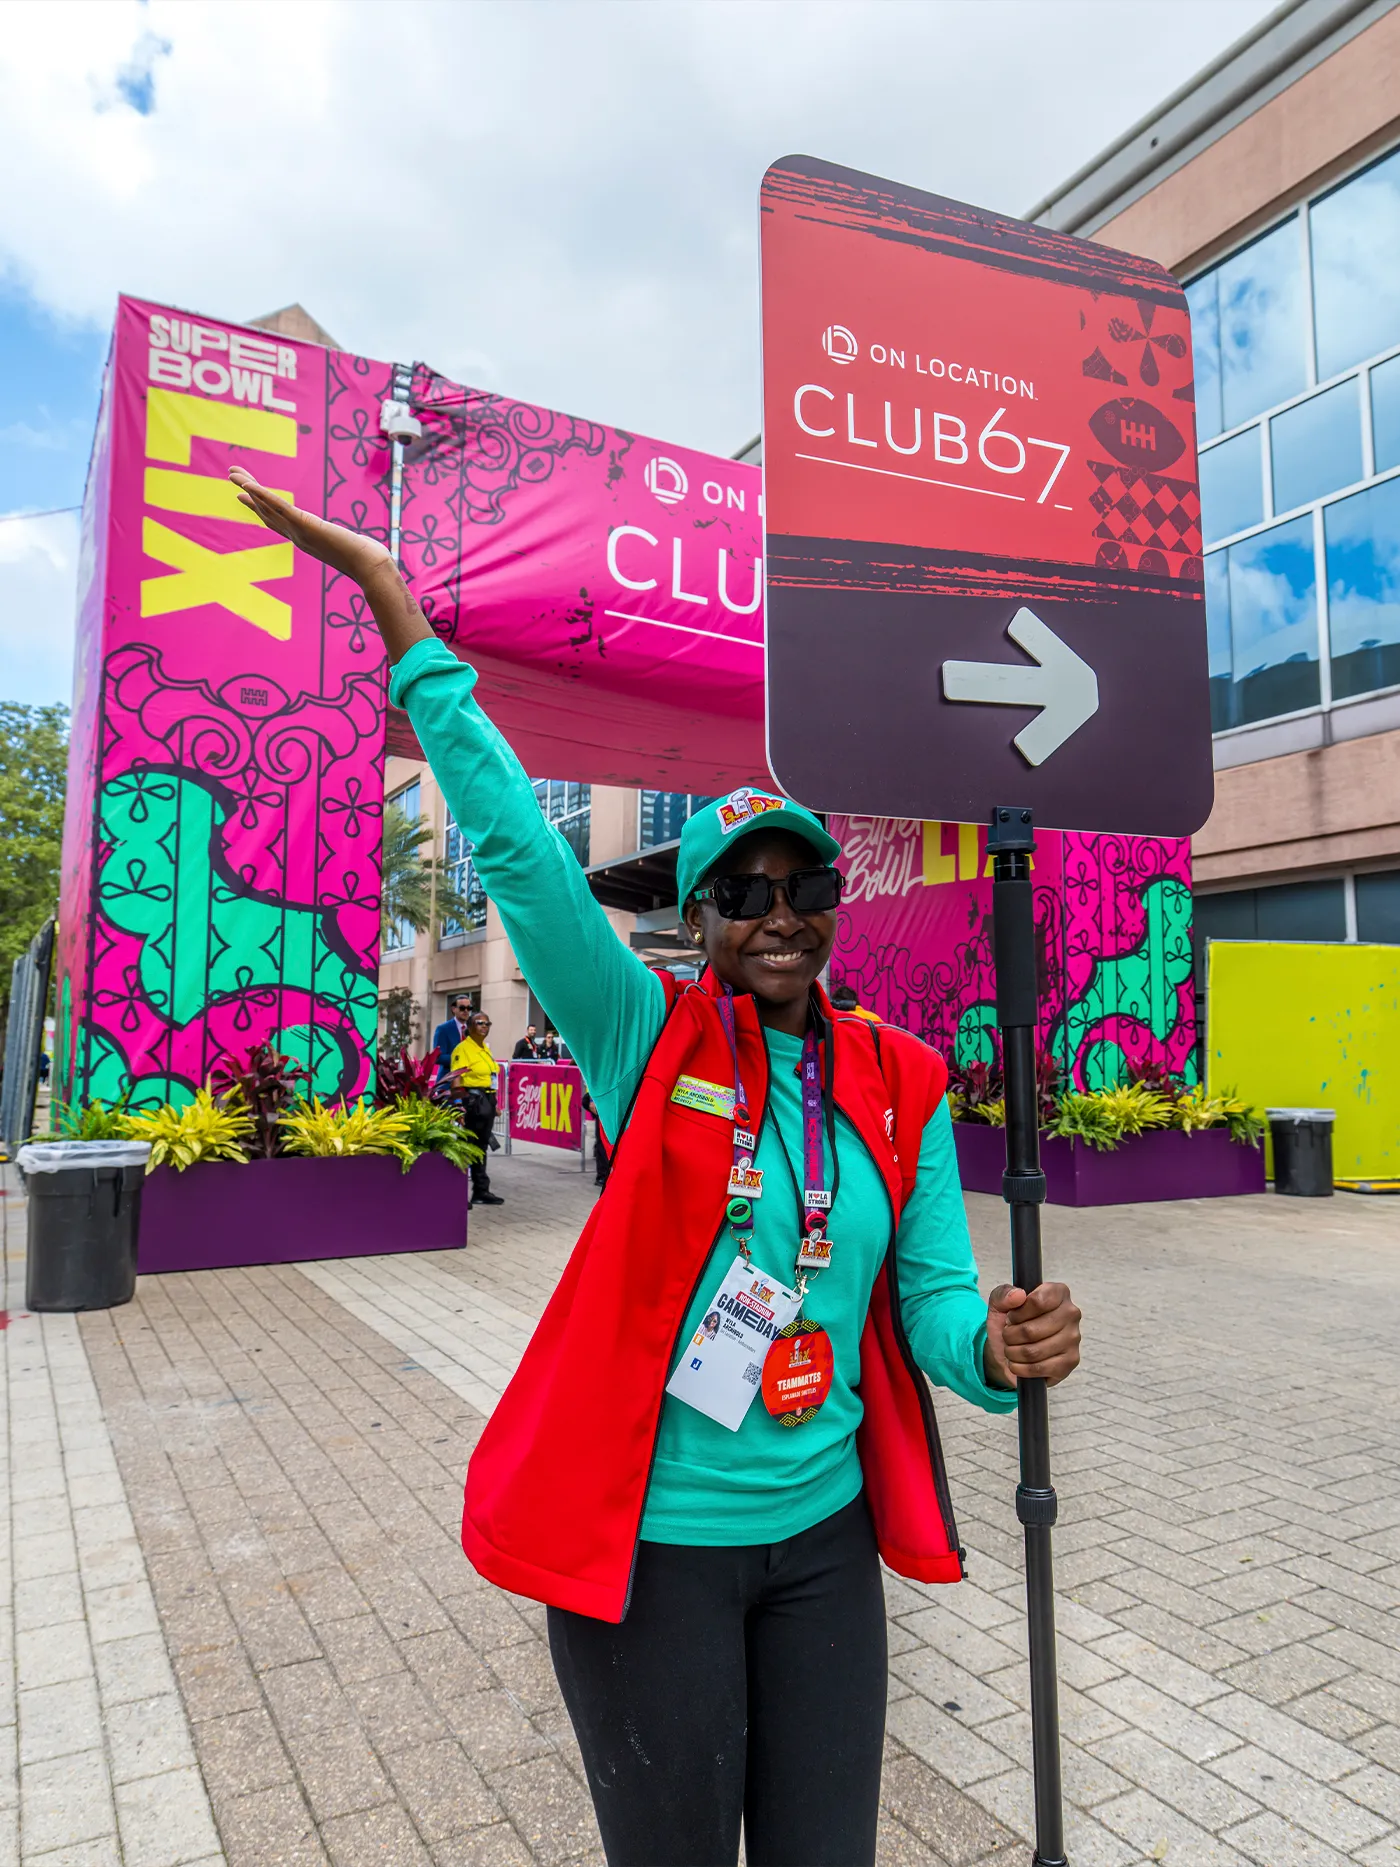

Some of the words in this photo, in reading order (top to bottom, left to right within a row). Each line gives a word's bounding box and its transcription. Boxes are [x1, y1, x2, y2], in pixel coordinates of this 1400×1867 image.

[149, 314, 297, 380] SUPER
[869, 344, 905, 369] ON
[916, 354, 1034, 400] LOCATION
[148, 348, 297, 413] BOWL
[794, 383, 1071, 504] CLUB67
[139, 387, 298, 641] LIX
[702, 481, 745, 512] ON
[606, 525, 762, 615] CLU
[540, 1081, 573, 1133] LIX
[736, 1138, 753, 1147] STRONG
[717, 1293, 781, 1341] GAMEDAY
[738, 1293, 772, 1319] NON-STADIUM
[777, 1372, 821, 1391] TEAMMATES
